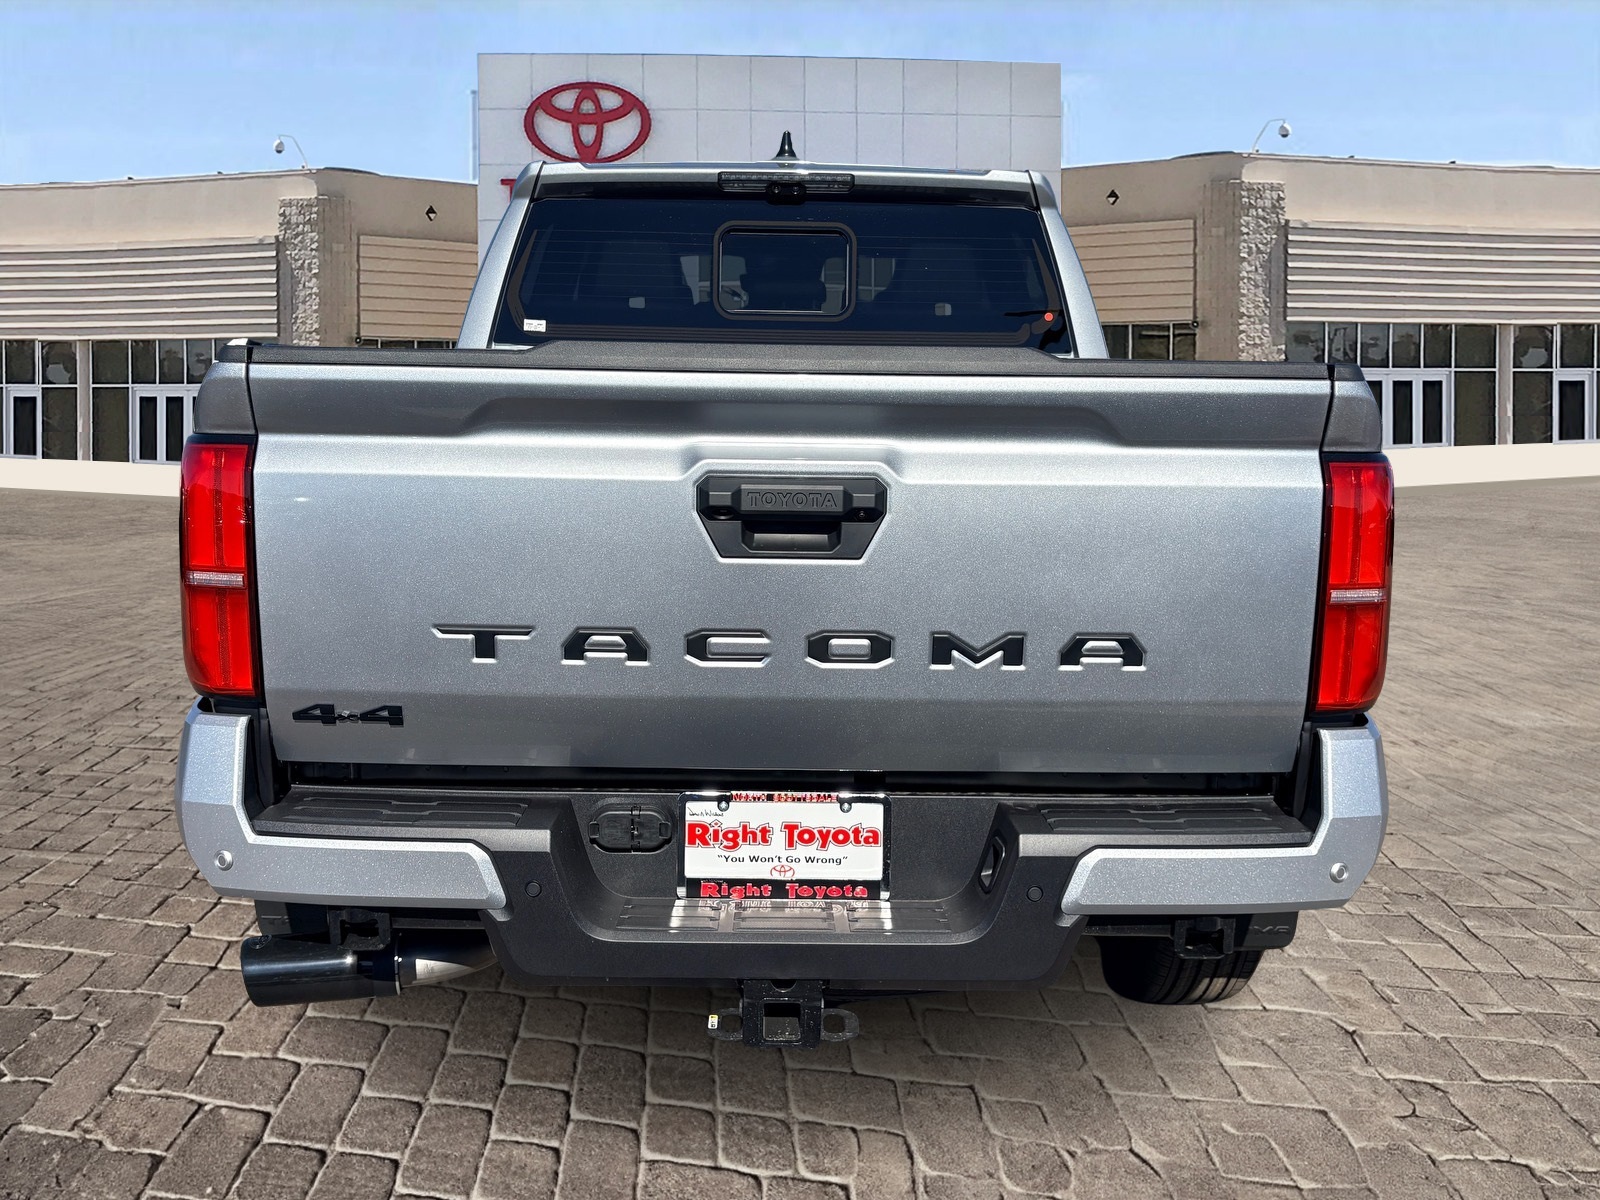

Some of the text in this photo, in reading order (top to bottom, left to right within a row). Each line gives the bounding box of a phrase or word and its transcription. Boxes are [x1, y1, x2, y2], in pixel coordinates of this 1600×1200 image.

[747, 491, 837, 508] TOYOTA
[431, 624, 1147, 671] TACOMA
[685, 820, 881, 851] Right Toyota
[748, 855, 782, 863] Won't
[785, 855, 801, 864] Go
[700, 882, 868, 900] Right Toyota
